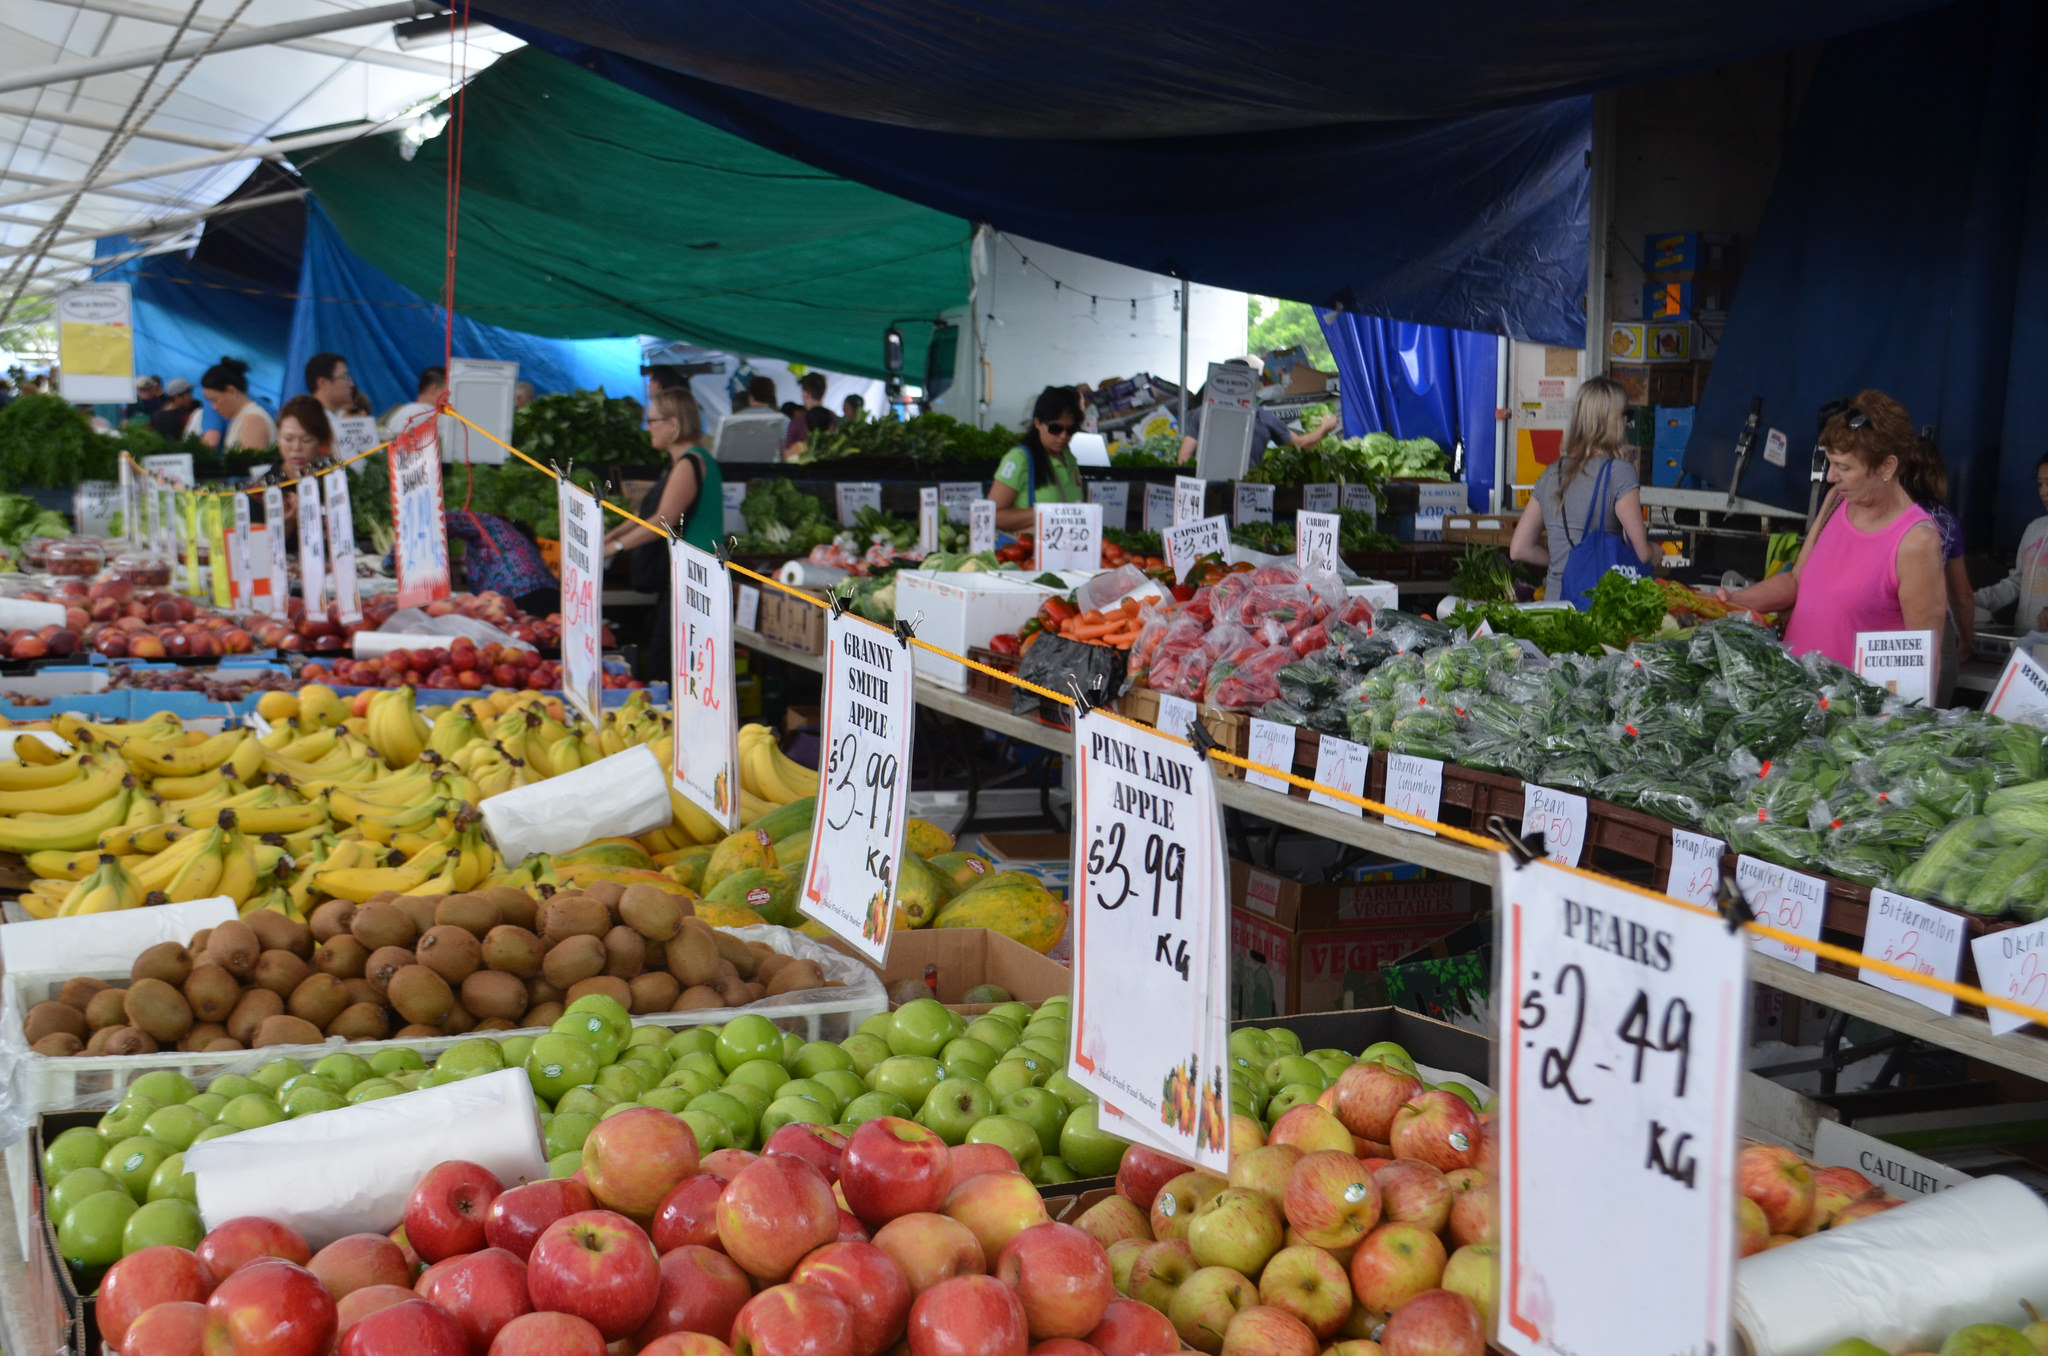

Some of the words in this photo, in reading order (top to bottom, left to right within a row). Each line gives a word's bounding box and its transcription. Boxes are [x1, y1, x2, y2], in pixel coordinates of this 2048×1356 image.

[1173, 521, 1219, 538] CAPSICUM
[1305, 517, 1330, 528] CARROT
[687, 558, 708, 588] KIWI
[686, 585, 711, 617] FRUIT
[844, 632, 893, 674] GRANNY
[1867, 638, 1922, 651] LEBANESE
[1864, 655, 1924, 667] CUCUMBER
[848, 667, 889, 705] SMITH
[847, 700, 888, 739] APPLE
[1090, 731, 1139, 774] PINK
[1142, 749, 1194, 796] LADY
[1112, 781, 1176, 831] APPLE
[1532, 789, 1566, 815] Bean
[1353, 898, 1454, 918] VEGETABLES
[1562, 897, 1674, 973] PEARS
[1860, 1151, 1954, 1195] CAULIFL
